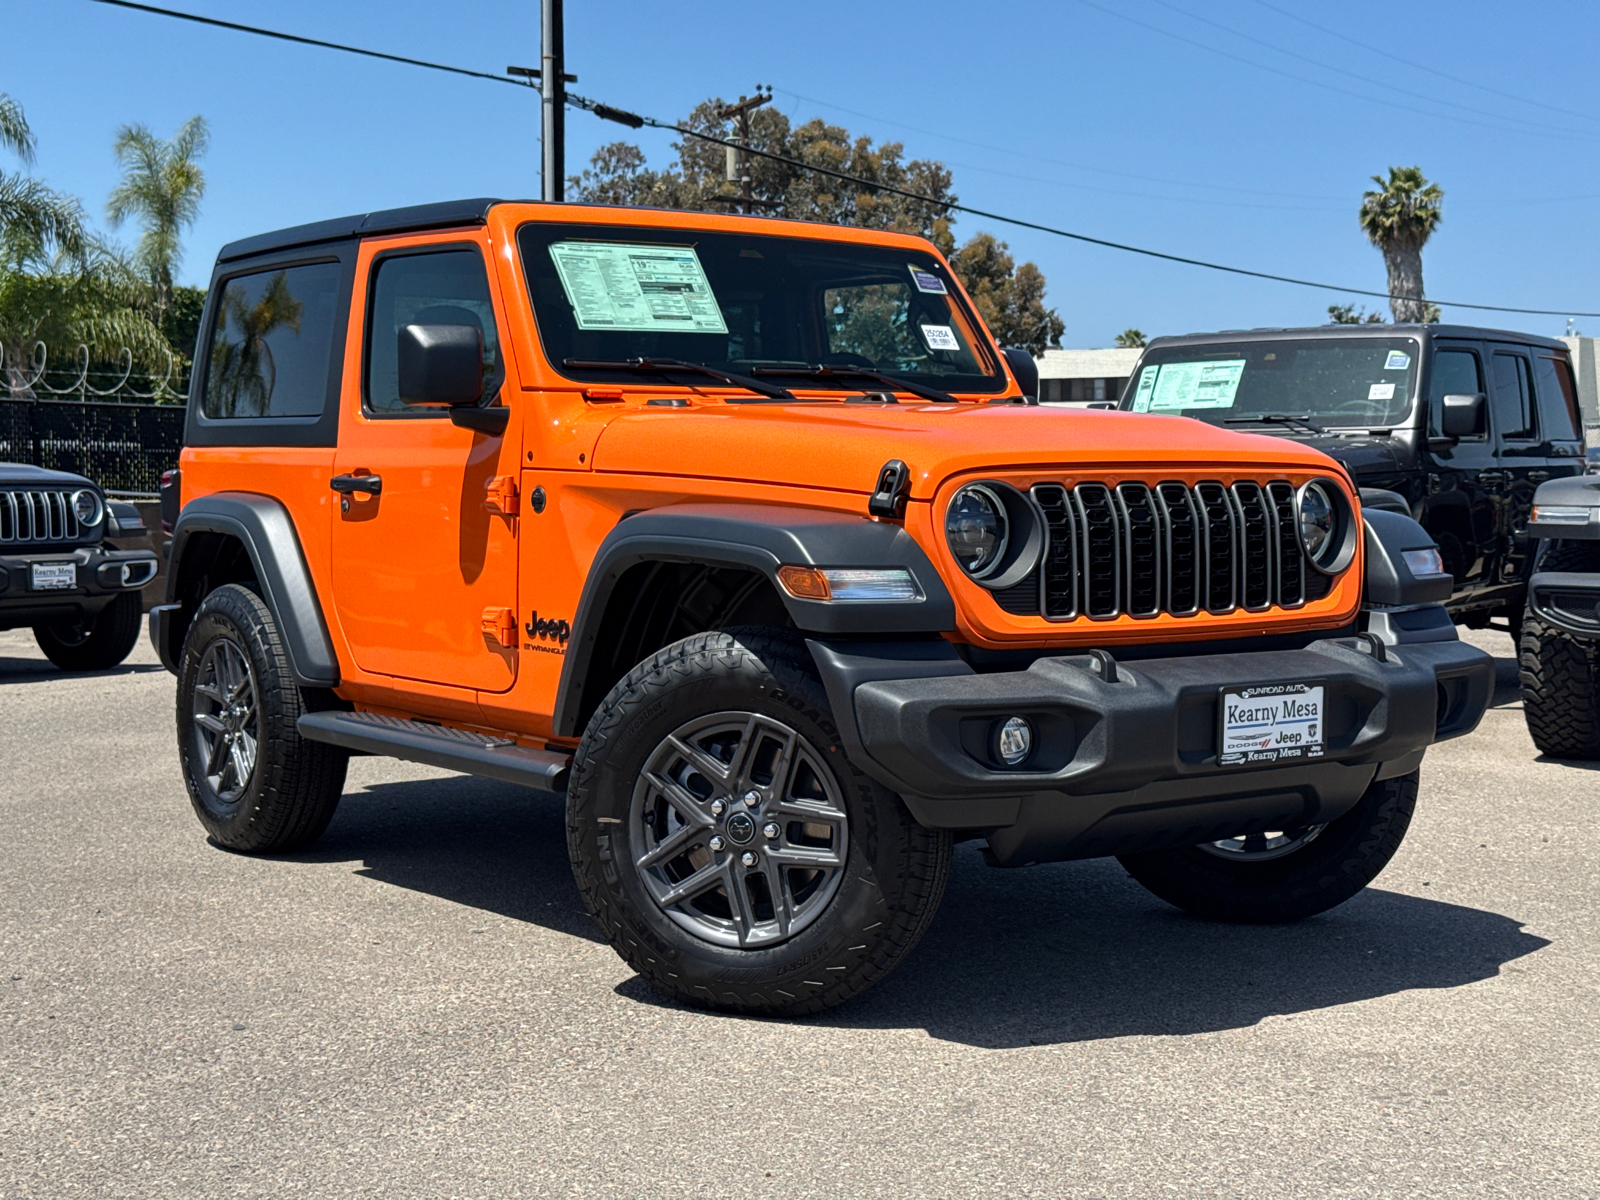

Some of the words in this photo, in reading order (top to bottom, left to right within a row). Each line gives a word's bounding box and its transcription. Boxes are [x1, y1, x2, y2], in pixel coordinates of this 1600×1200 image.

[525, 610, 570, 645] Jeep
[532, 644, 567, 655] WRANGLE
[1247, 686, 1284, 695] SUNROAD
[1286, 684, 1306, 693] AUTO
[1227, 705, 1279, 726] Kearny
[1283, 700, 1318, 718] Mesa
[1275, 731, 1302, 745] Jeep
[1247, 751, 1278, 762] Kearny
[1279, 747, 1302, 758] Mesa
